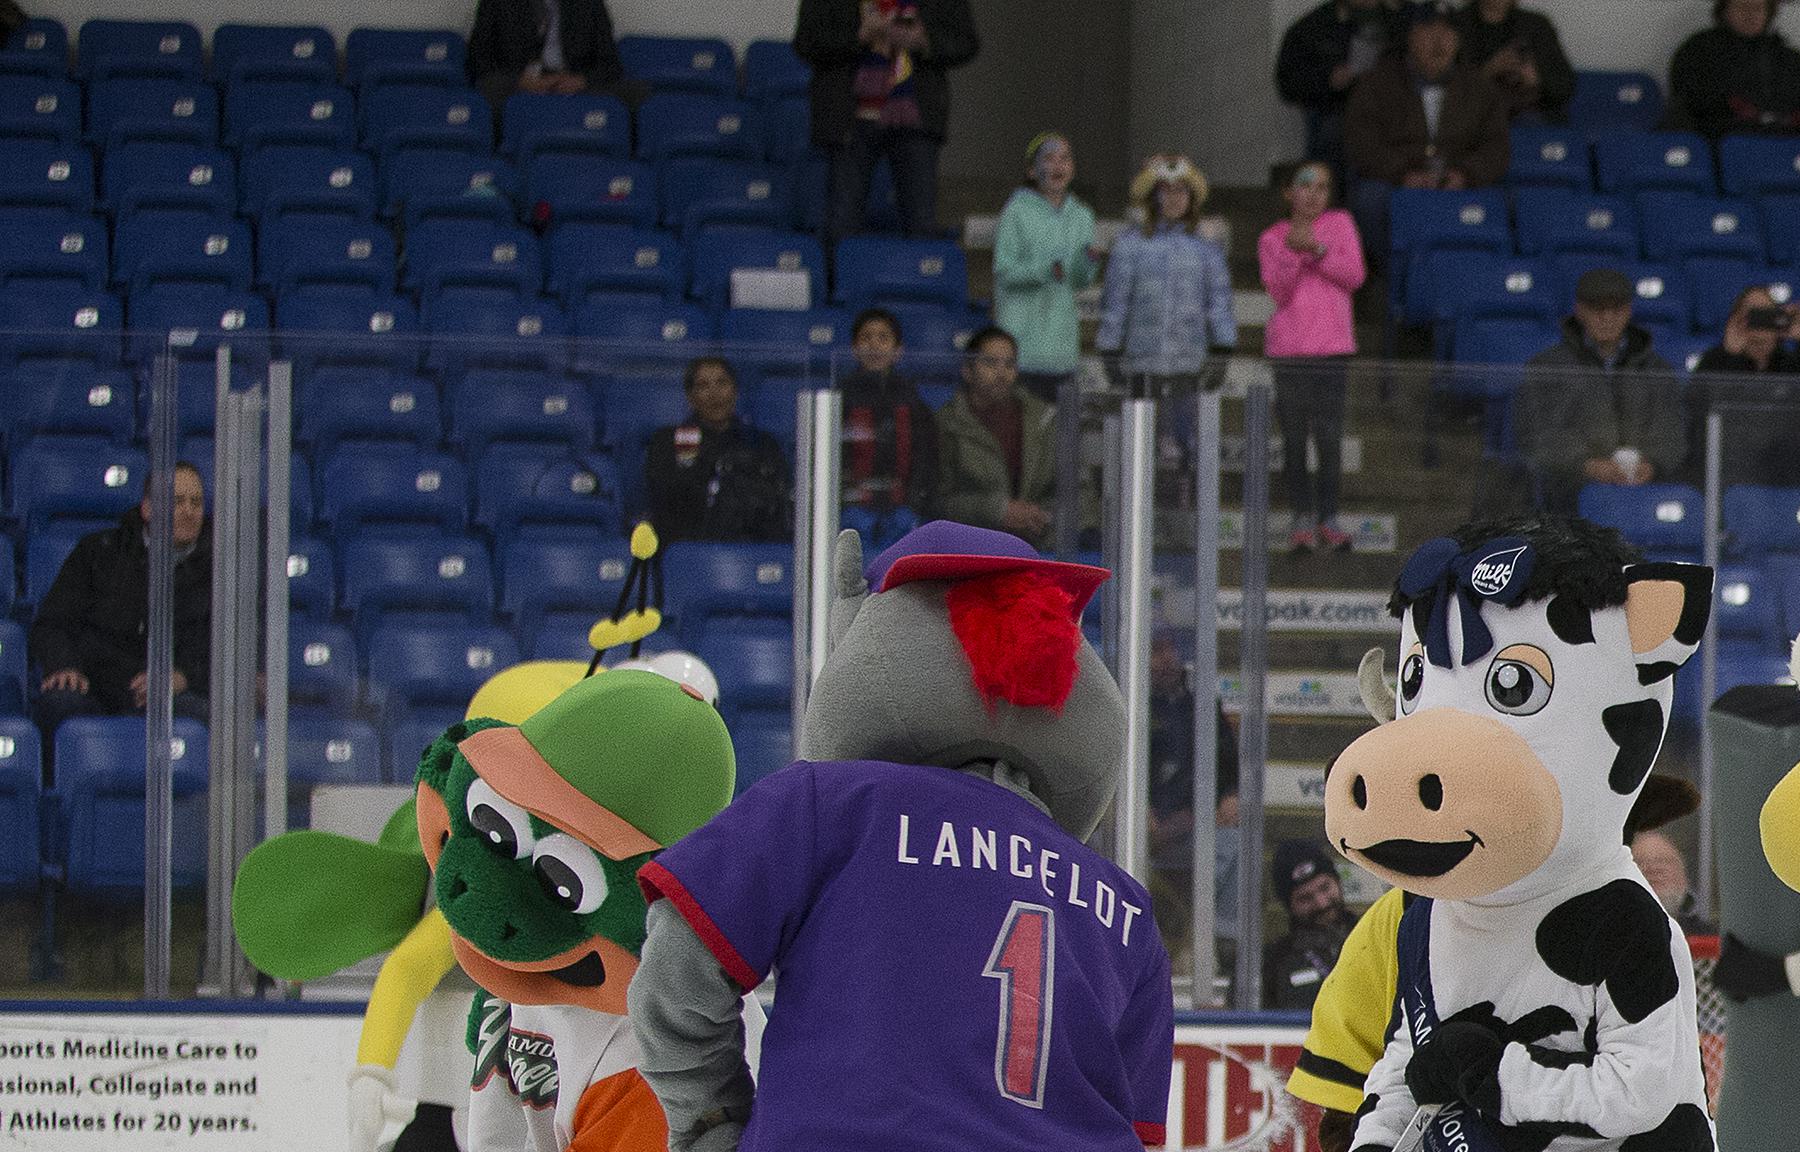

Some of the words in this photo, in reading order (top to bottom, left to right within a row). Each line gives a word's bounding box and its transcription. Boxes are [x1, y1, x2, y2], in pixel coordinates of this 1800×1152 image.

[898, 814, 1141, 946] LANCELOT
[981, 900, 1055, 1110] 1
[63, 1038, 169, 1059] Medicine
[175, 1040, 227, 1059] Care
[234, 1041, 257, 1058] to
[90, 1074, 206, 1099] Collegiate
[214, 1074, 257, 1094] and
[9, 1110, 105, 1130] Athletes
[112, 1110, 145, 1130] for
[154, 1112, 181, 1130] 20
[189, 1114, 257, 1135] years.
